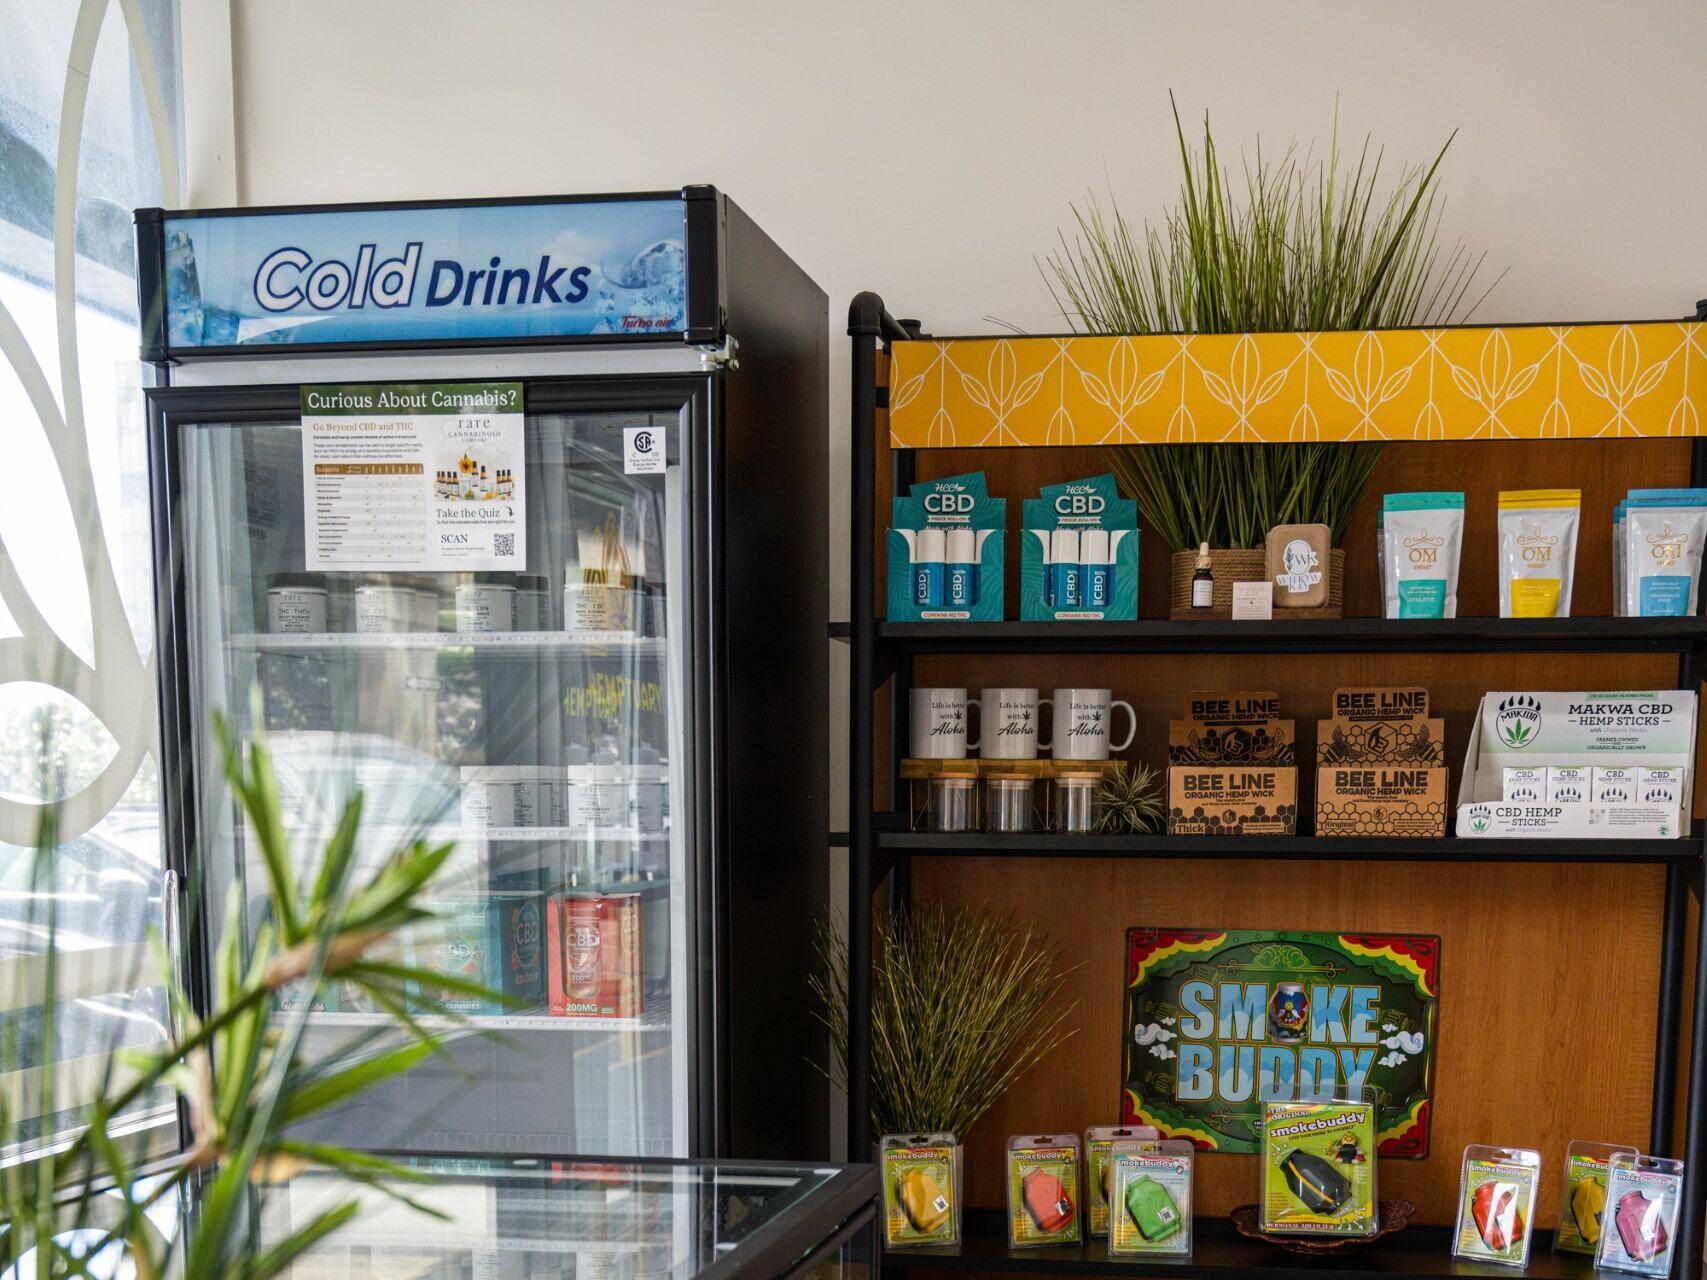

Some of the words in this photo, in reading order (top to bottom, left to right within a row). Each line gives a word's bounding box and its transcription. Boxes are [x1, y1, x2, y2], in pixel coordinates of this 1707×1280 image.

[253, 242, 424, 313] Cold
[425, 255, 592, 308] Drinks
[308, 392, 373, 409] Curious
[377, 391, 428, 408] About
[431, 390, 517, 408] Cannabis?
[313, 423, 324, 431] Go
[326, 423, 357, 433] Beyond
[358, 422, 376, 431] CBD
[379, 422, 394, 430] and
[396, 422, 414, 430] THC
[458, 419, 491, 429] rare
[924, 493, 975, 513] CBD
[1055, 495, 1106, 514] CBD
[436, 508, 459, 518] Take
[461, 508, 476, 518] the
[479, 508, 500, 519] Quiz
[441, 534, 468, 543] SCAN
[1408, 548, 1437, 564] OM
[1522, 547, 1552, 563] OM
[918, 574, 927, 597] CBD
[953, 574, 962, 598] CBD
[1066, 574, 1076, 598] CBD
[1094, 575, 1103, 600] CBD
[1336, 692, 1376, 708] BEE
[1381, 691, 1426, 707] LINE
[1191, 700, 1230, 714] BEE
[1235, 699, 1280, 713] LINE
[1337, 708, 1377, 716] ORGANIC
[1377, 707, 1401, 715] HEMP
[1568, 704, 1632, 715] MAKWA
[1638, 703, 1673, 715] CBD
[1257, 712, 1280, 720] WICK
[1500, 711, 1538, 722] MAKWA
[1579, 716, 1614, 726] HEMP
[1616, 716, 1660, 726] STICKS
[930, 722, 965, 736] Aloha
[998, 722, 1033, 736] Aloha
[1068, 722, 1104, 736] Aloha
[1335, 771, 1376, 787] BEE
[1381, 771, 1428, 787] LINE
[1606, 770, 1624, 778] CBD
[1183, 774, 1224, 791] BEE
[1229, 773, 1276, 790] LINE
[1184, 791, 1224, 799] ORGANIC
[1403, 787, 1427, 795] WICK
[1495, 807, 1522, 817] CBD
[1525, 807, 1562, 817] HEMP
[1176, 824, 1204, 833] Thick
[1512, 818, 1547, 826] STICKS
[445, 1002, 480, 1010] GUMMIES
[566, 1003, 598, 1013] 200MG
[1176, 1043, 1378, 1103] BUDDY
[1271, 1110, 1311, 1121] ORIGINAL
[1269, 1112, 1366, 1138] smokebuddy
[1120, 1159, 1173, 1168] smokebuddy
